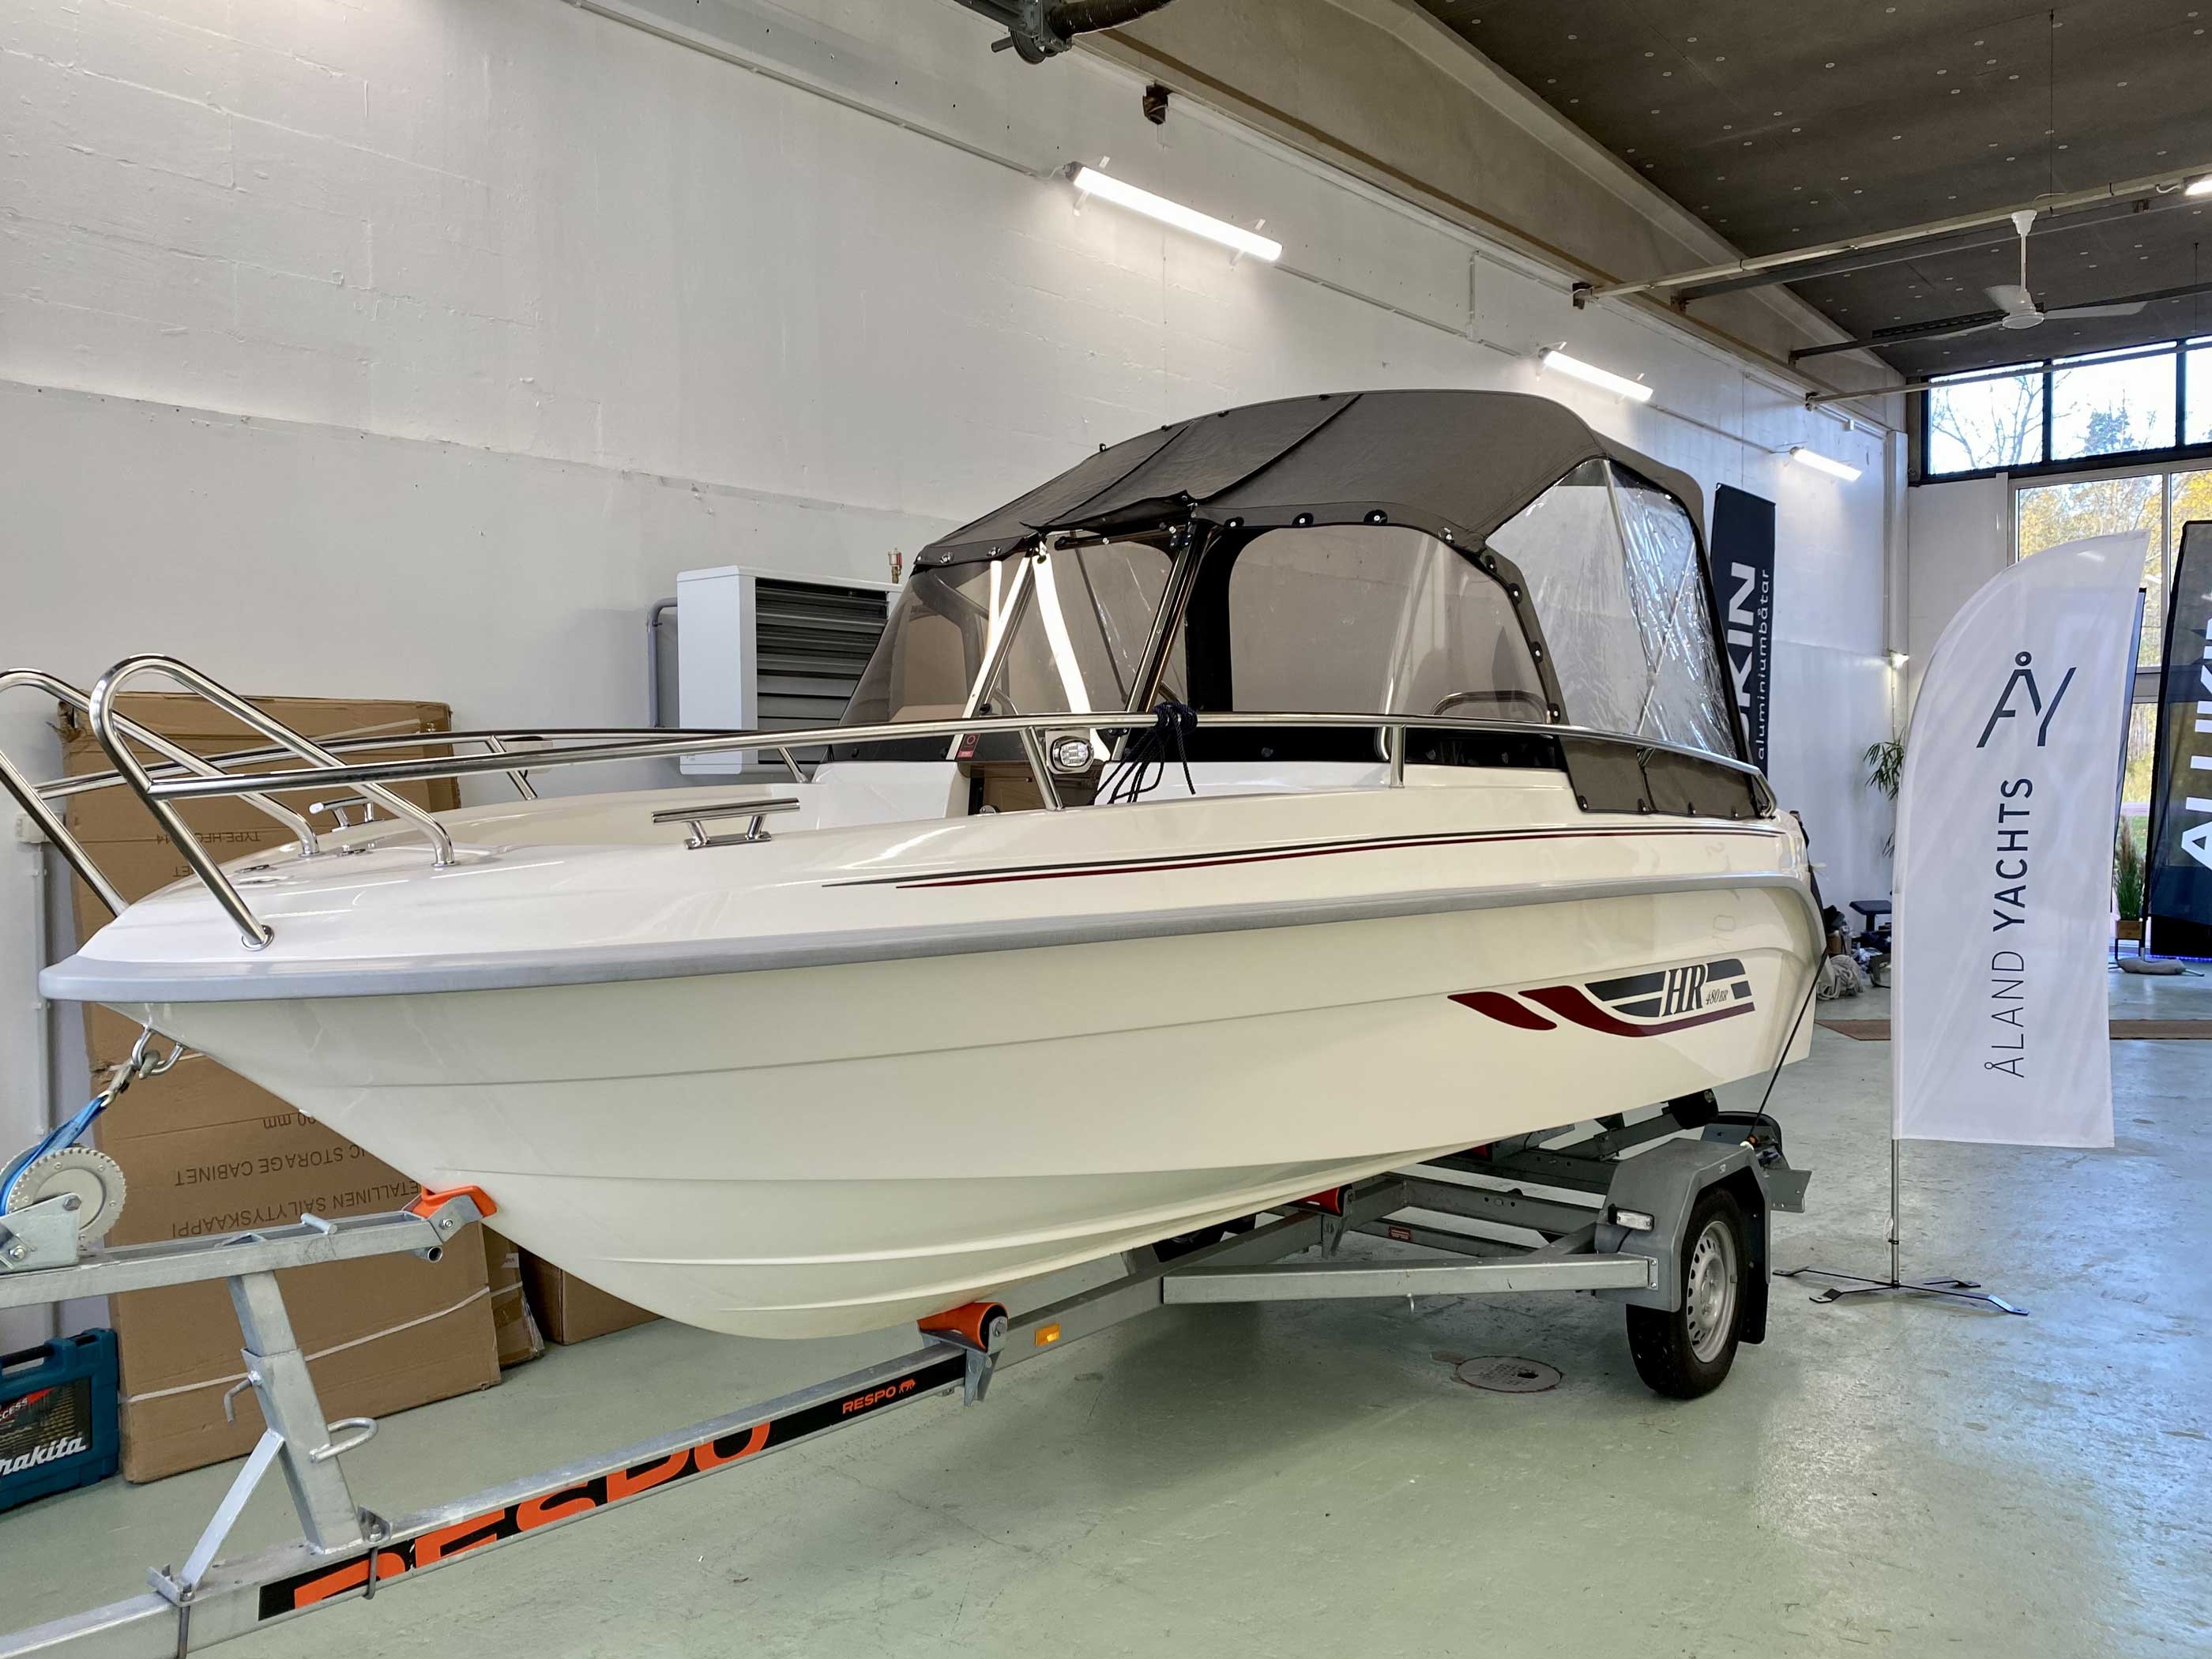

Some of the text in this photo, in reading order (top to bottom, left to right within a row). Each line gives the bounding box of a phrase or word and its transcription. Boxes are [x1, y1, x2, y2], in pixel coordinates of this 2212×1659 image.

[1755, 569, 1770, 760] aluminiumbåtar
[1984, 778, 2033, 1078] ÅLAND YACHTS
[1661, 964, 1706, 1017] HR
[175, 1161, 254, 1187] CABINET
[258, 1146, 344, 1174] STORAGE
[332, 1180, 421, 1209] ETALLINEN
[841, 1386, 897, 1414] RESPO
